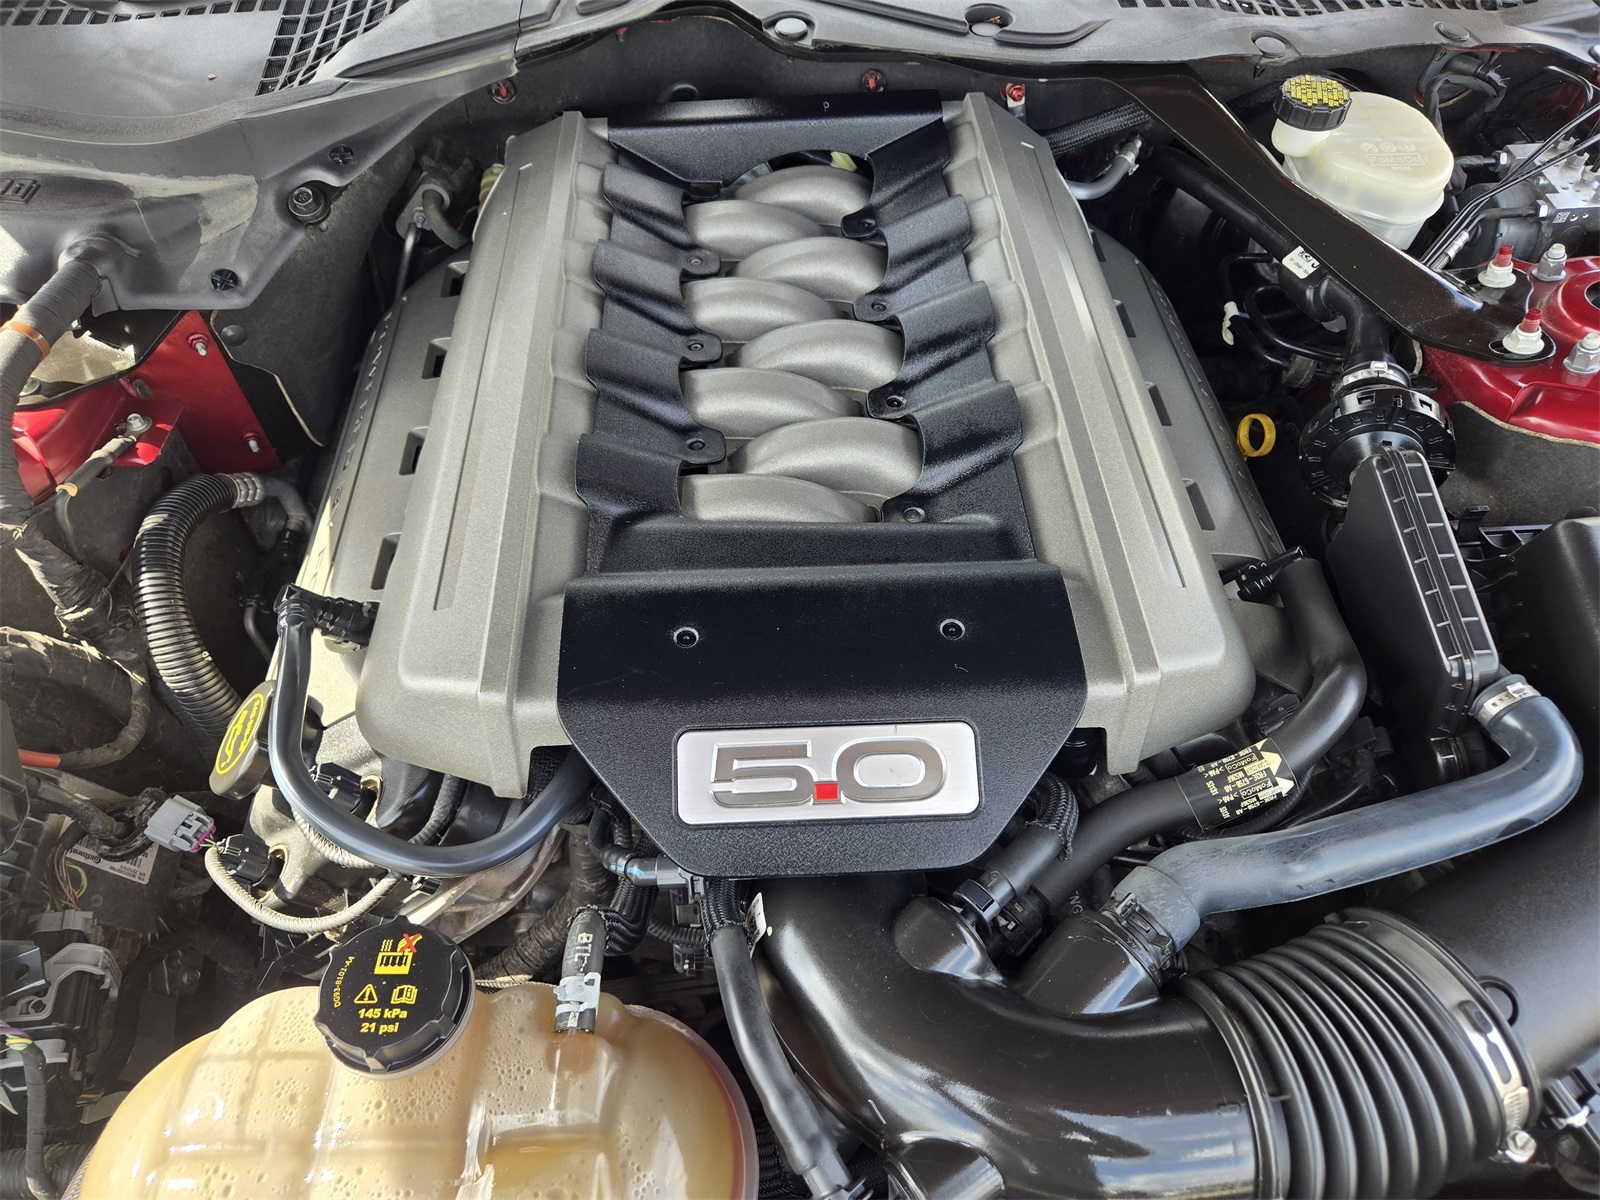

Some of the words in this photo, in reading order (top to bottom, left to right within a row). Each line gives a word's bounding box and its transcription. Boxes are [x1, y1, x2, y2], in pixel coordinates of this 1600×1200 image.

[1227, 755, 1258, 770] FoMoCo
[709, 735, 947, 809] 5.0
[1241, 780, 1272, 796] FoMoCo
[70, 848, 101, 864] Continent
[333, 956, 356, 1008] DG93-8101-AA
[358, 1008, 380, 1018] 145
[384, 1008, 408, 1018] kPa
[360, 1022, 376, 1033] 21
[378, 1022, 400, 1034] psi
